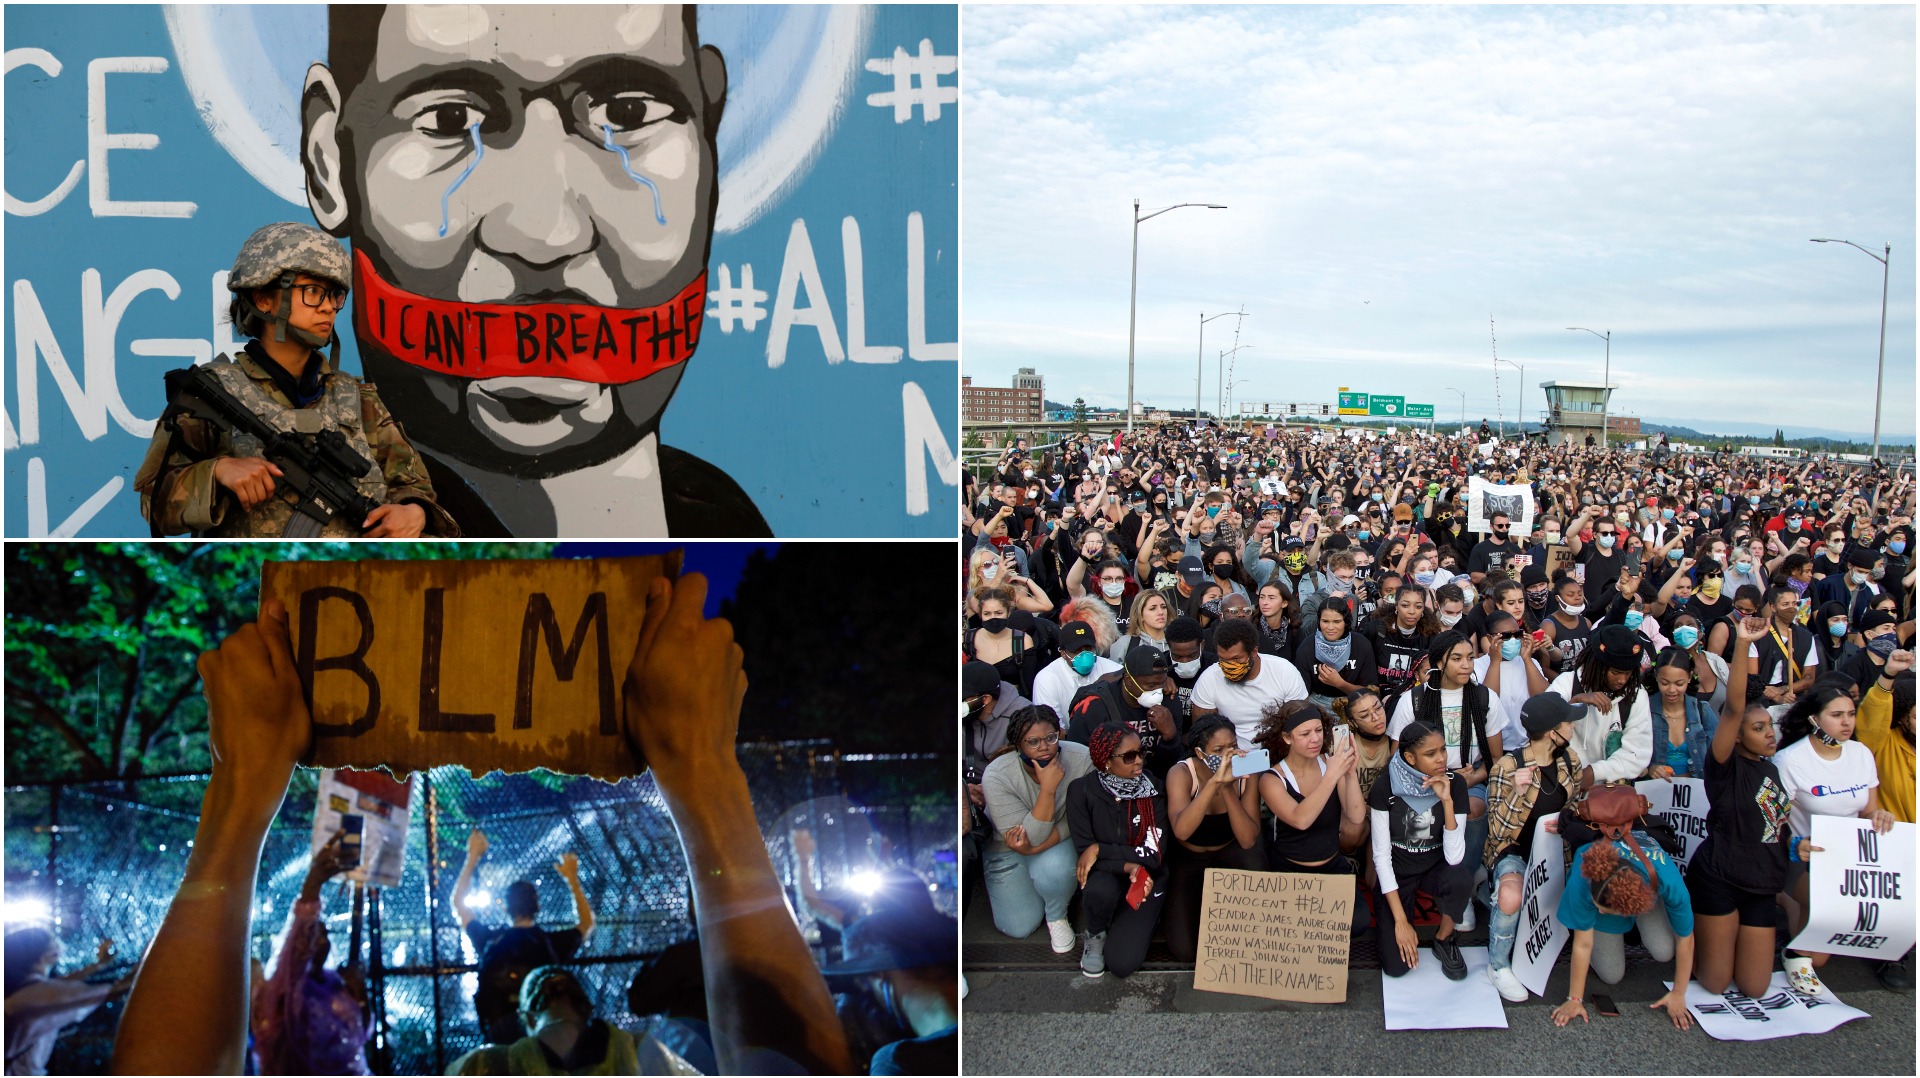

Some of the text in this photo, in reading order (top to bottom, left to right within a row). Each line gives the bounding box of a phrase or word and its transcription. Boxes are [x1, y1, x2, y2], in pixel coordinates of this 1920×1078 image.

[378, 291, 701, 369] I CAN'T BREATHE
[298, 585, 618, 736] BLM
[1672, 783, 1691, 808] NO
[1811, 783, 1868, 798] Champion
[1660, 811, 1706, 839] USTICE
[1857, 828, 1879, 863] NO
[1212, 871, 1325, 893] PORTLAND ISN'T
[1840, 868, 1902, 900] JUSTICE
[1213, 891, 1288, 910] INNOCENT
[1528, 895, 1539, 930] NO
[1208, 907, 1256, 921] KENDRA
[1260, 912, 1292, 925] JAMES
[1297, 916, 1325, 929] ANDRE
[1854, 901, 1879, 932] NO
[1207, 920, 1260, 934] QUANICE
[1265, 926, 1298, 939] HAYES
[1304, 930, 1334, 942] KEATON
[1525, 914, 1553, 965] PEACE!
[1827, 933, 1888, 949] PEACE!
[1204, 934, 1347, 956] JASON WASHINGTON PATRICK
[1204, 945, 1246, 959] TERRELL
[1252, 951, 1300, 965] JOHNSON
[1203, 958, 1335, 991] SAY THEIR NAMES
